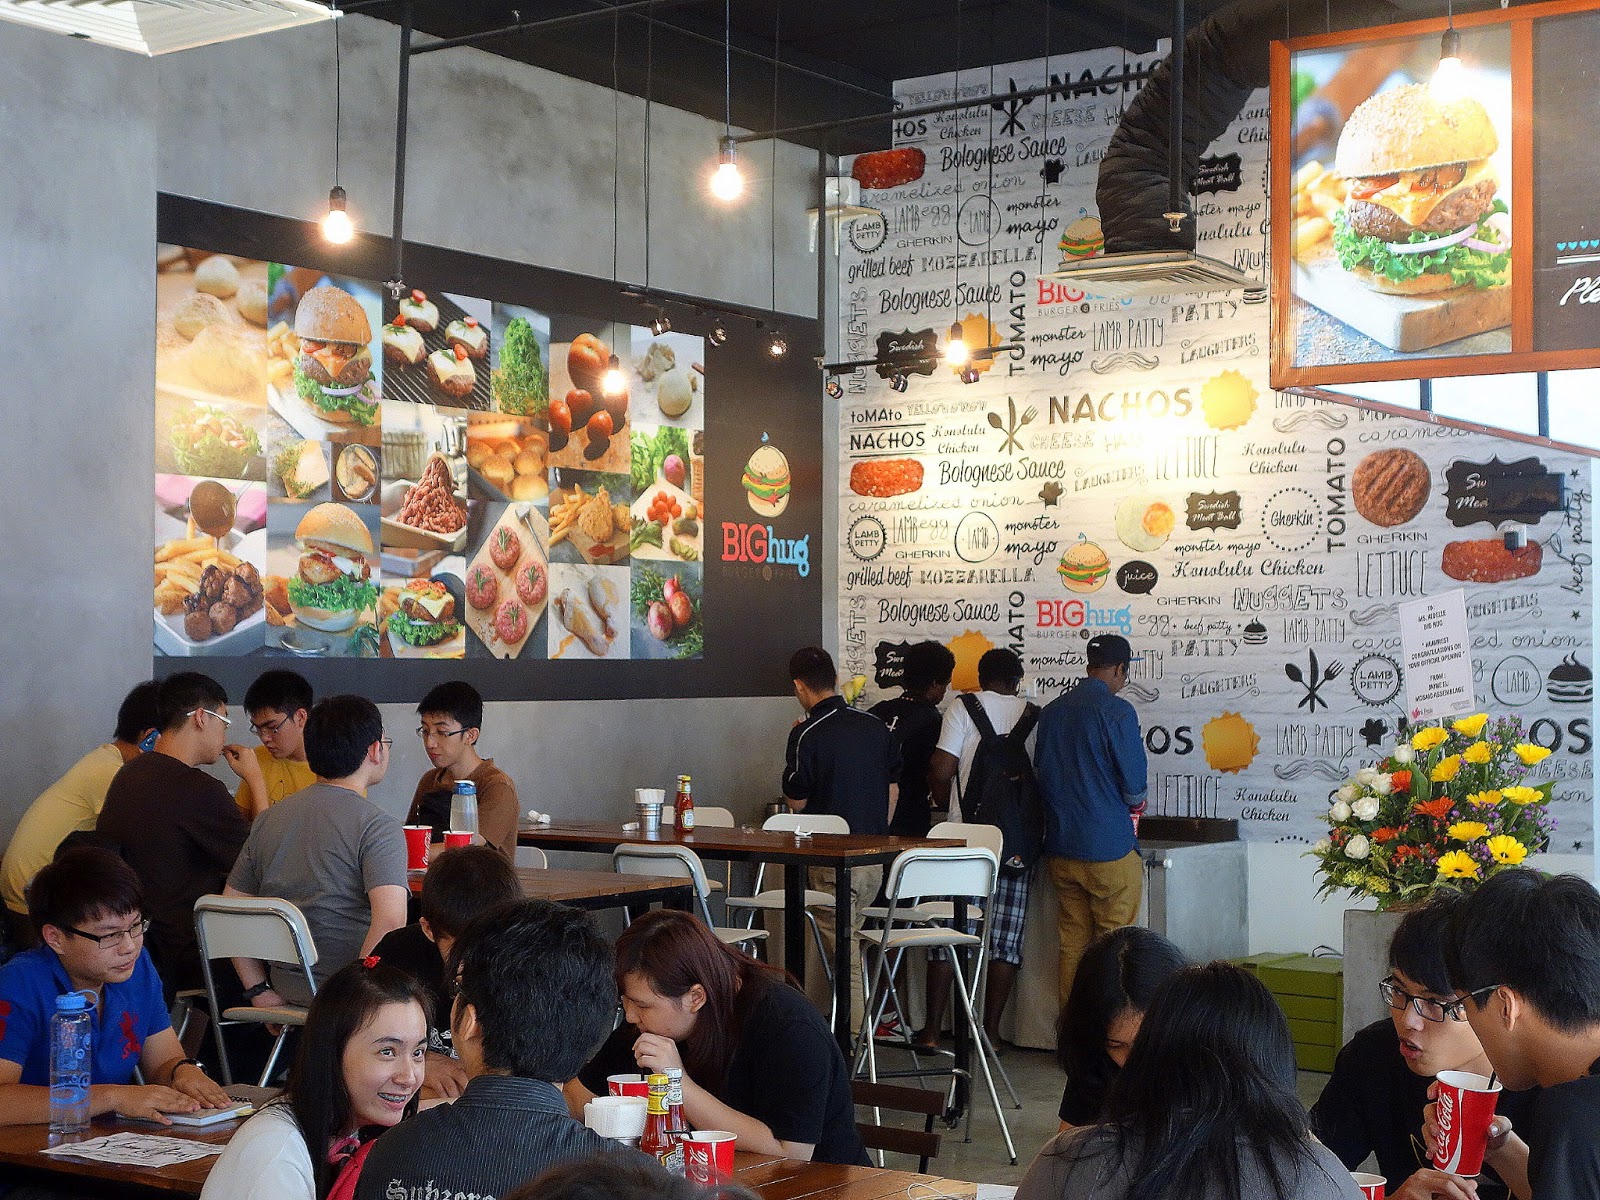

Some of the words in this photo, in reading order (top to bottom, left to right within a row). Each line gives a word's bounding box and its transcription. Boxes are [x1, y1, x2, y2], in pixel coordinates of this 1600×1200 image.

[940, 126, 981, 139] Chicken
[940, 144, 1015, 172] Bolognese
[1018, 135, 1067, 163] Sauce
[1006, 193, 1061, 213] monster
[1227, 202, 1261, 218] mayo
[856, 221, 881, 232] LAMB
[894, 204, 920, 235] LAMB
[1006, 216, 1059, 243] mayo
[896, 236, 952, 249] GHERKIN
[848, 258, 886, 283] grilled
[889, 254, 915, 277] beef
[878, 287, 951, 314] Bolognese
[955, 282, 1002, 306] Sauce
[1037, 305, 1078, 316] BURGER
[1171, 300, 1238, 323] PATTY
[1009, 269, 1026, 377] TOMATO
[1030, 324, 1086, 347] monster
[1093, 319, 1122, 351] LAMB
[1128, 317, 1165, 349] PATTY
[1180, 332, 1256, 364] LAUGHTERS
[1030, 350, 1083, 376] mayo
[1048, 387, 1194, 425] NACHOS
[849, 431, 926, 451] NACHOS
[938, 441, 979, 454] Chicken
[938, 459, 1013, 488] Bolognese
[1017, 456, 1066, 480] Sauce
[1250, 459, 1299, 474] Chicken
[970, 492, 1024, 507] onion
[1326, 437, 1346, 553] TOMATO
[1004, 514, 1060, 535] monster
[1270, 508, 1314, 527] Gherkin
[855, 529, 880, 538] LAMB
[893, 515, 918, 544] LAMB
[919, 517, 949, 540] egg
[968, 526, 989, 550] LAMB
[1356, 531, 1428, 544] GHERKIN
[895, 549, 951, 559] GHERKIN
[1004, 539, 1058, 565] mayo
[1174, 538, 1223, 555] monster
[1227, 541, 1262, 557] mayo
[847, 565, 885, 590] grilled
[887, 564, 913, 588] beef
[920, 567, 1036, 584] MOZZARELLA
[1260, 558, 1325, 576] Chicken
[1357, 549, 1429, 597] LETTUCE
[1123, 569, 1155, 588] juice
[1157, 595, 1221, 606] GHERKIN
[878, 598, 950, 626] Bolognese
[953, 599, 1000, 621] Sauce
[1037, 630, 1078, 639] BURGER
[1138, 614, 1172, 637] egg
[1183, 616, 1205, 635] beef
[1206, 619, 1233, 635] patty
[1283, 616, 1309, 643] LAMB
[1314, 616, 1346, 643] PATTY
[1171, 639, 1242, 657] PATTY
[1512, 630, 1582, 647] onion
[1030, 650, 1086, 669] monster
[1131, 650, 1164, 680] ATTY
[1359, 669, 1394, 680] LAMB
[1506, 670, 1531, 694] LAMB
[1181, 672, 1257, 699] LAUGHTERS
[1359, 680, 1394, 690] PETTY
[1276, 723, 1308, 756] LAMB
[1315, 724, 1355, 757] PATTY
[1241, 806, 1290, 821] Chicken
